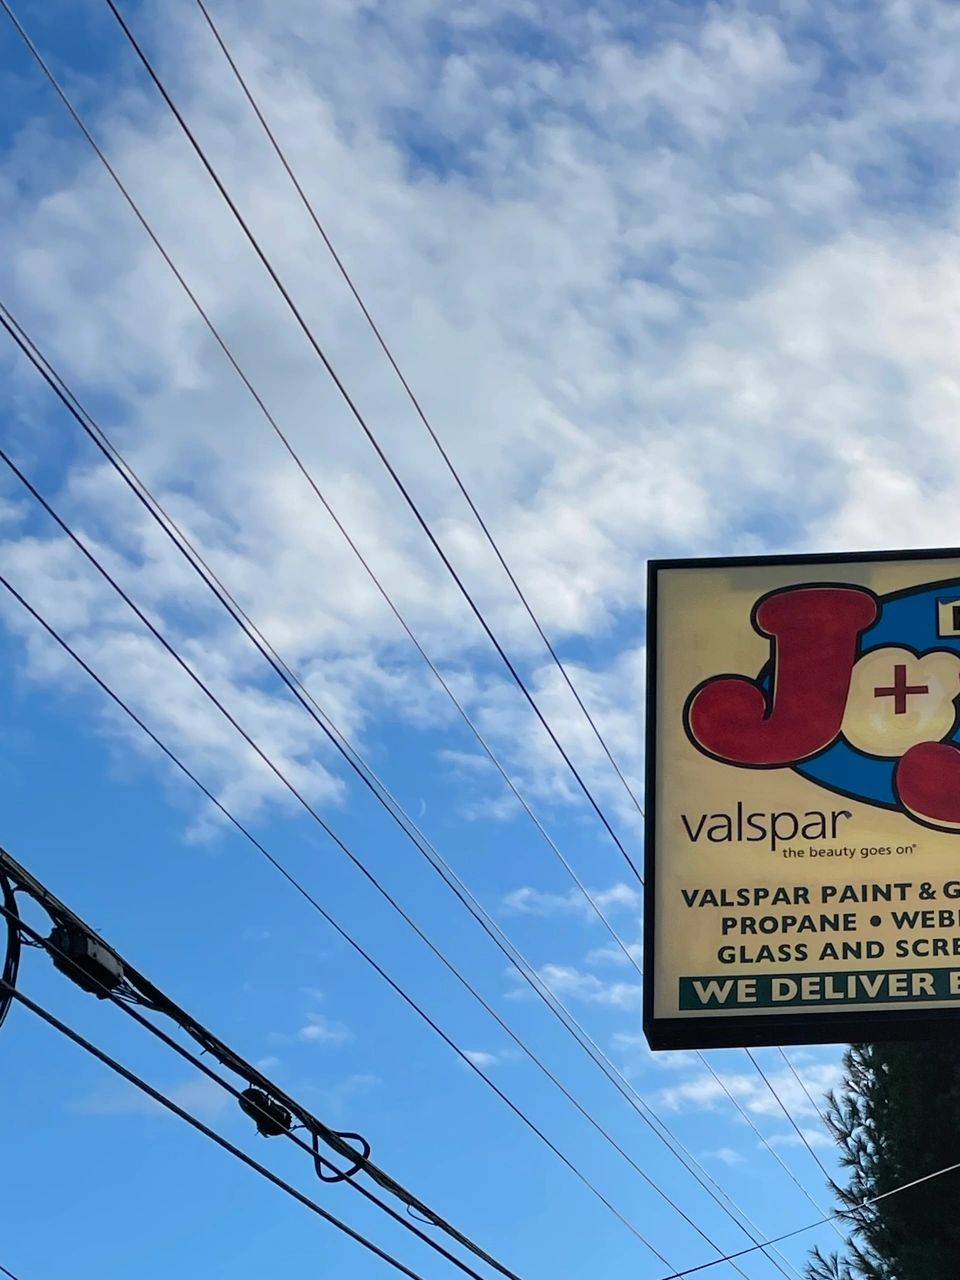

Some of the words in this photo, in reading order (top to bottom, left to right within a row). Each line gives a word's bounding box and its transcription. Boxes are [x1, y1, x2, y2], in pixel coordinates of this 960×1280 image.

[681, 801, 852, 852] valspar
[783, 848, 805, 858] the
[809, 847, 856, 858] beauty
[860, 846, 892, 858] goes
[896, 846, 913, 854] on
[681, 887, 811, 907] VALSPAR
[821, 882, 912, 905] PAINT
[919, 881, 937, 900] &
[721, 913, 858, 936] PROPANE
[717, 944, 809, 964] GLASS
[819, 941, 885, 962] AND
[692, 979, 758, 1005] WE
[771, 973, 936, 1002] DELIVER
